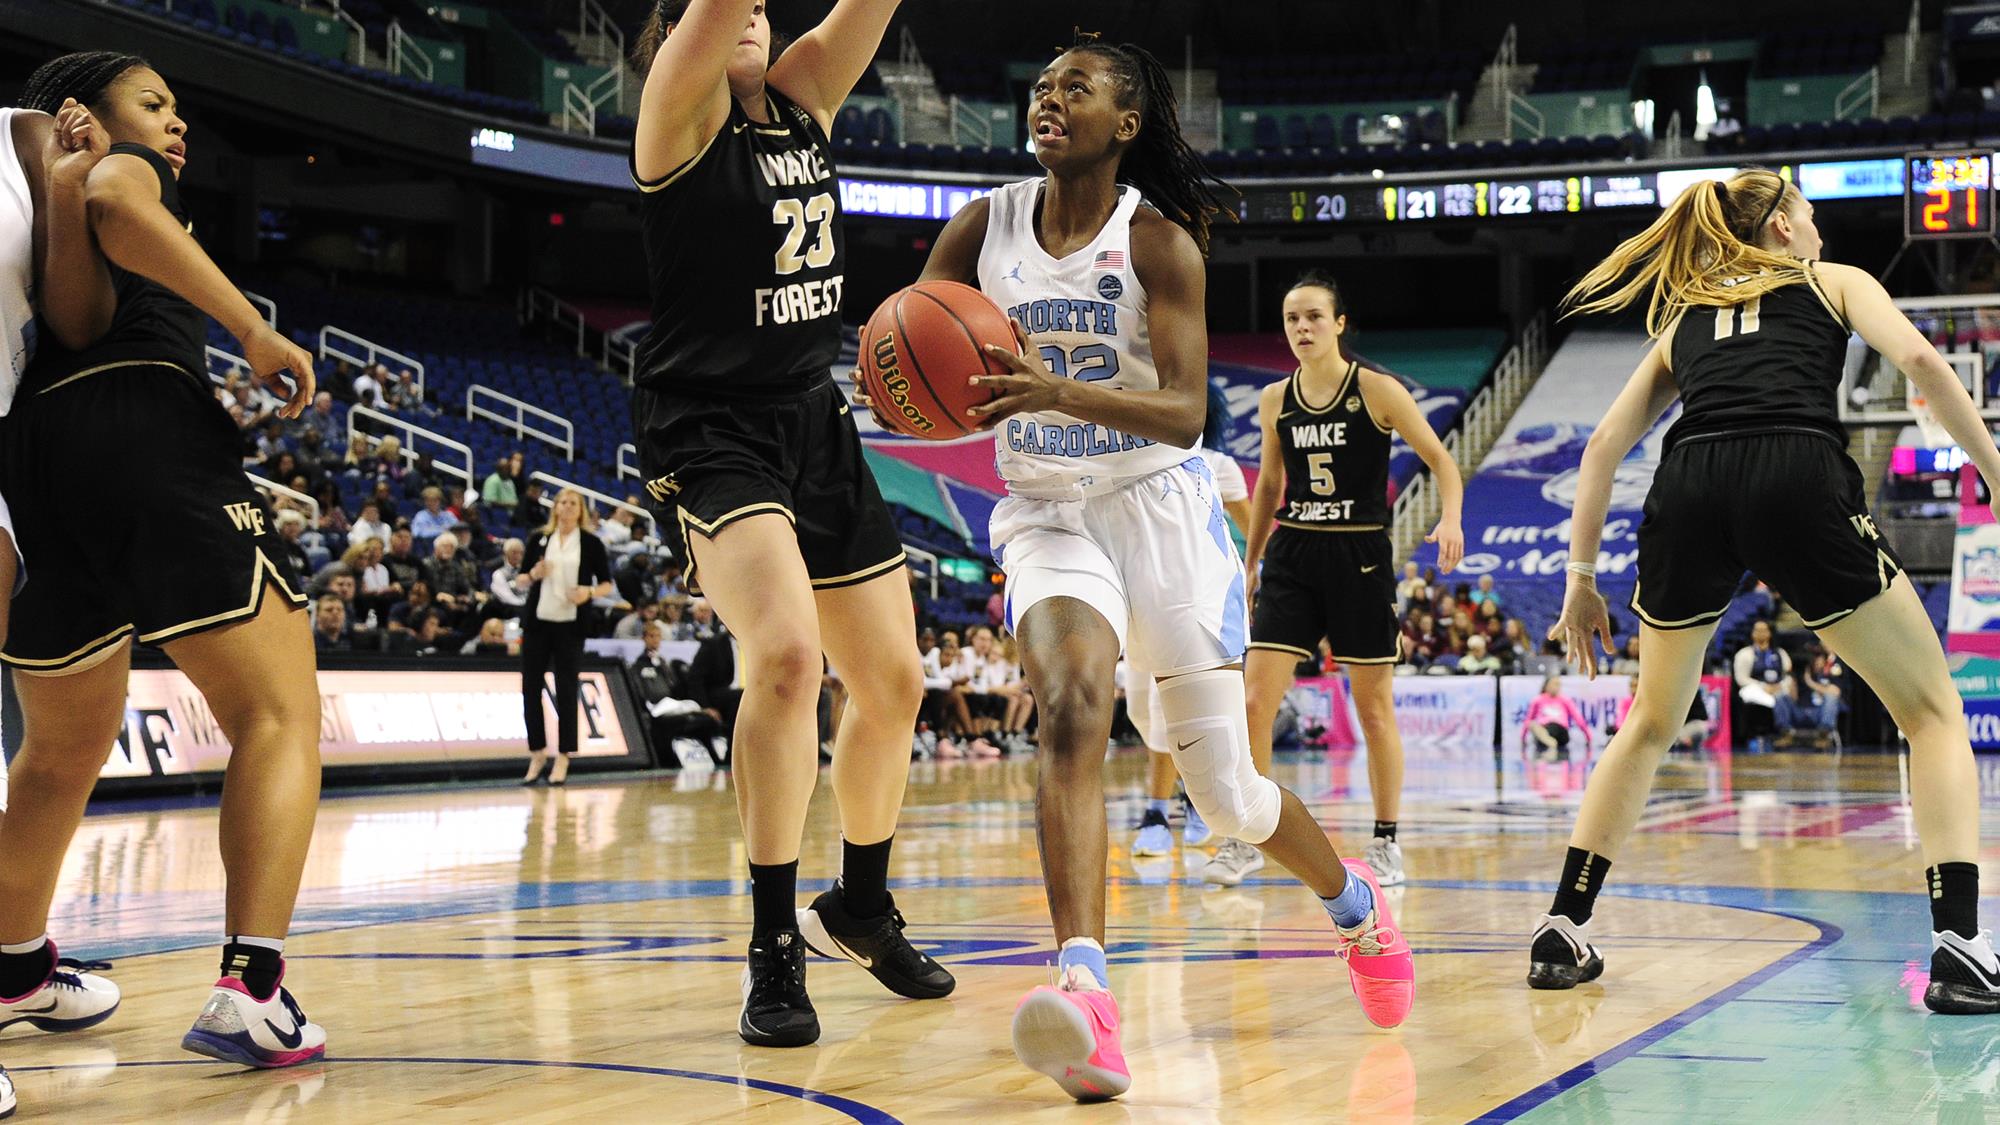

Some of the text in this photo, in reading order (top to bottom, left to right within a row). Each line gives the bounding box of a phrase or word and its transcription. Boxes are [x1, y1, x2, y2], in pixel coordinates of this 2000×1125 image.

[755, 142, 831, 186] WAKE
[1315, 194, 1347, 221] 20
[1406, 190, 1437, 219] 21
[1498, 185, 1532, 215] 22
[1922, 187, 1977, 231] 21
[772, 192, 835, 275] 23
[755, 275, 844, 327] FOREST
[1008, 298, 1117, 336] NORTH
[1714, 295, 1761, 341] 11
[873, 331, 936, 433] Wilson
[1007, 419, 1157, 458] CAROLIN
[1291, 422, 1347, 449] WAKE
[1306, 452, 1336, 496] 5
[222, 501, 267, 537] WF
[1287, 500, 1355, 521] FOREST
[1396, 713, 1485, 737] RNAMENT
